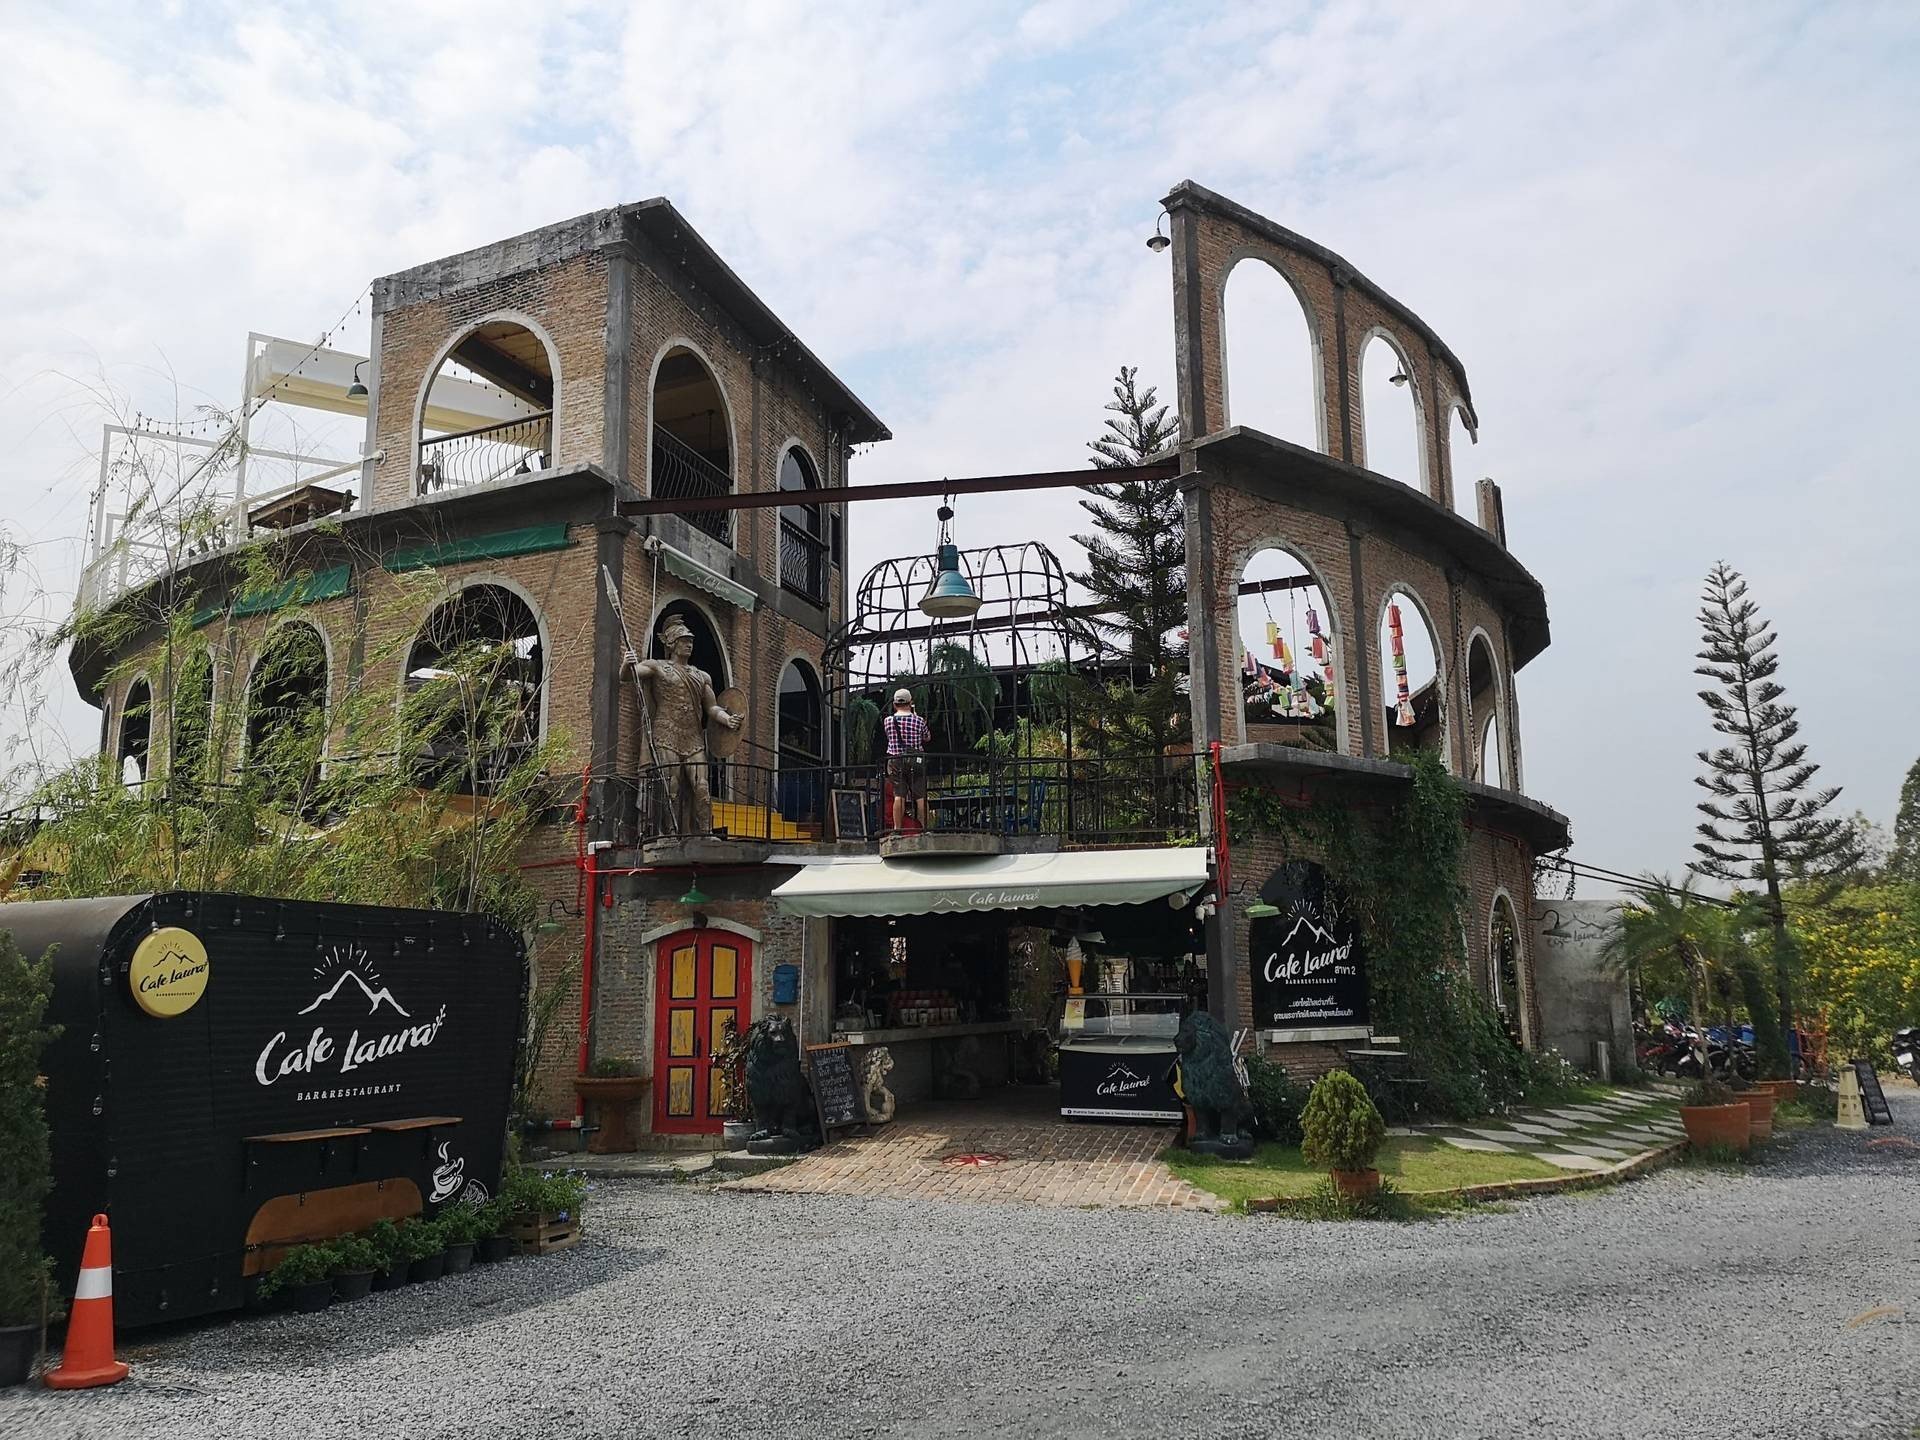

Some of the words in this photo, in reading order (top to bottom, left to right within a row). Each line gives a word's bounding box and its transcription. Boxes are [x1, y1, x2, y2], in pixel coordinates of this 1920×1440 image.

[968, 892, 996, 906] Cafe
[999, 889, 1039, 904] Laura
[1264, 952, 1301, 982] Cafe
[1303, 935, 1352, 977] Laura
[140, 973, 167, 993] Cafe
[169, 962, 207, 984] Laura
[1334, 965, 1351, 975] สาขา
[1351, 965, 1357, 975] 2
[255, 1026, 335, 1086] Cafe
[340, 1006, 445, 1074] Laura
[296, 1083, 402, 1101] BAR&RESTAURANT
[1096, 1082, 1119, 1096] Cafe
[1119, 1076, 1150, 1092] Laura
